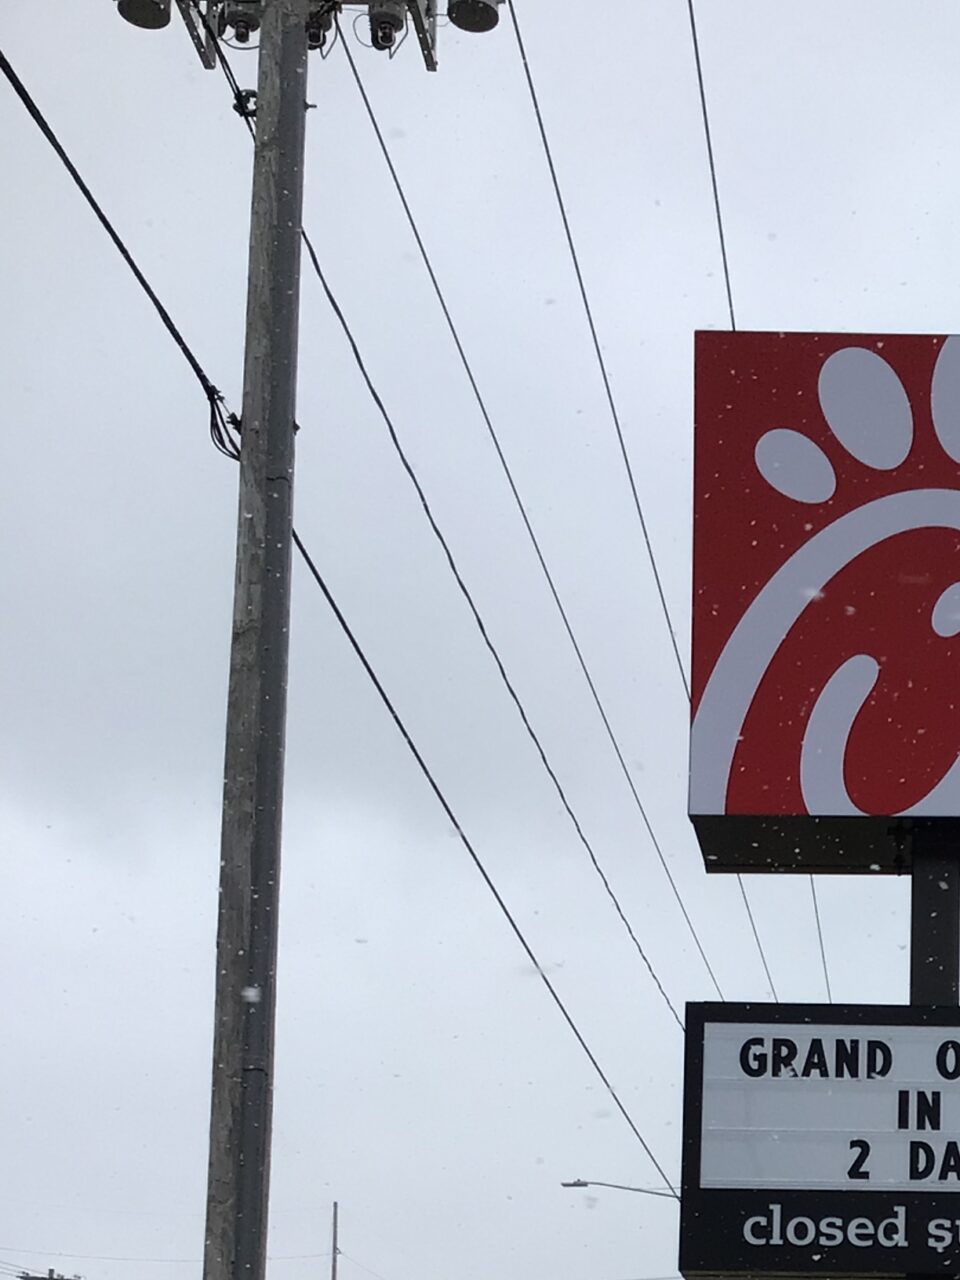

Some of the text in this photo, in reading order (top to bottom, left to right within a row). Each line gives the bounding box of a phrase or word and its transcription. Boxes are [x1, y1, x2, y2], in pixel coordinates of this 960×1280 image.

[739, 1037, 893, 1079] GRAND
[897, 1090, 941, 1131] IN
[847, 1139, 871, 1180] 2
[742, 1203, 909, 1248] closed
